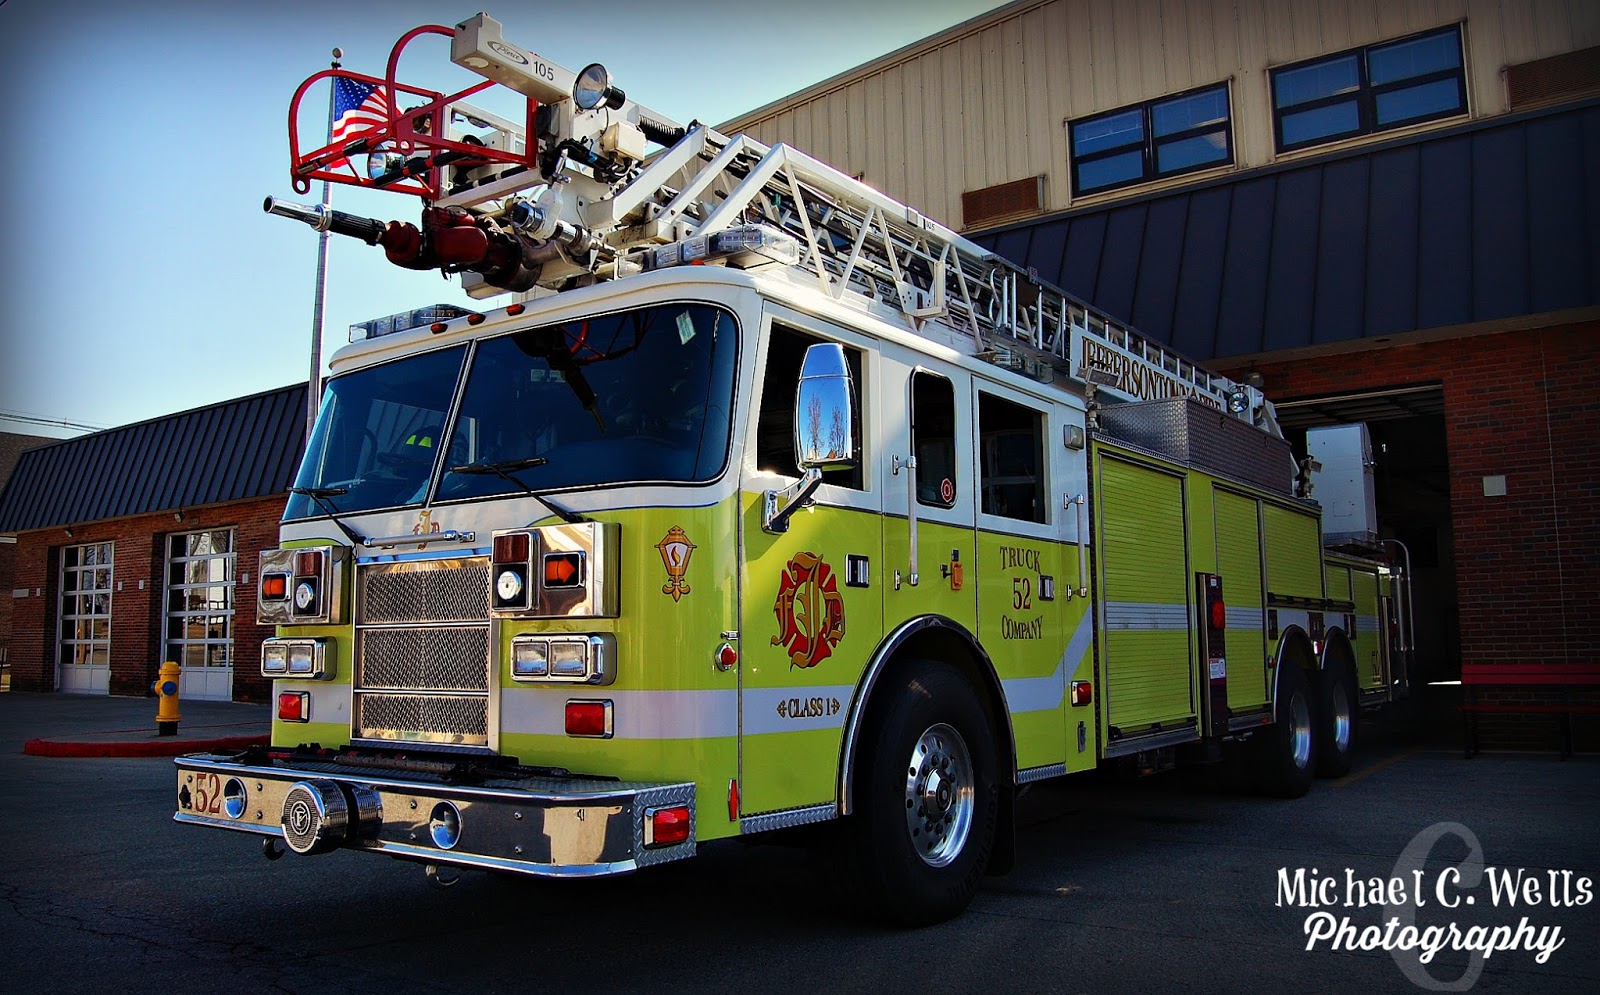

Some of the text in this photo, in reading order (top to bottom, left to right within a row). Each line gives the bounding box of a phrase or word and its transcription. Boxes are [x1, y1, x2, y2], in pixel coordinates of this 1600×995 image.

[533, 60, 554, 81] 105
[1000, 546, 1041, 575] TRUCK
[1013, 577, 1031, 610] 52
[1001, 614, 1043, 640] COMPANY
[788, 697, 831, 718] CLASS 1
[195, 773, 221, 814] 52
